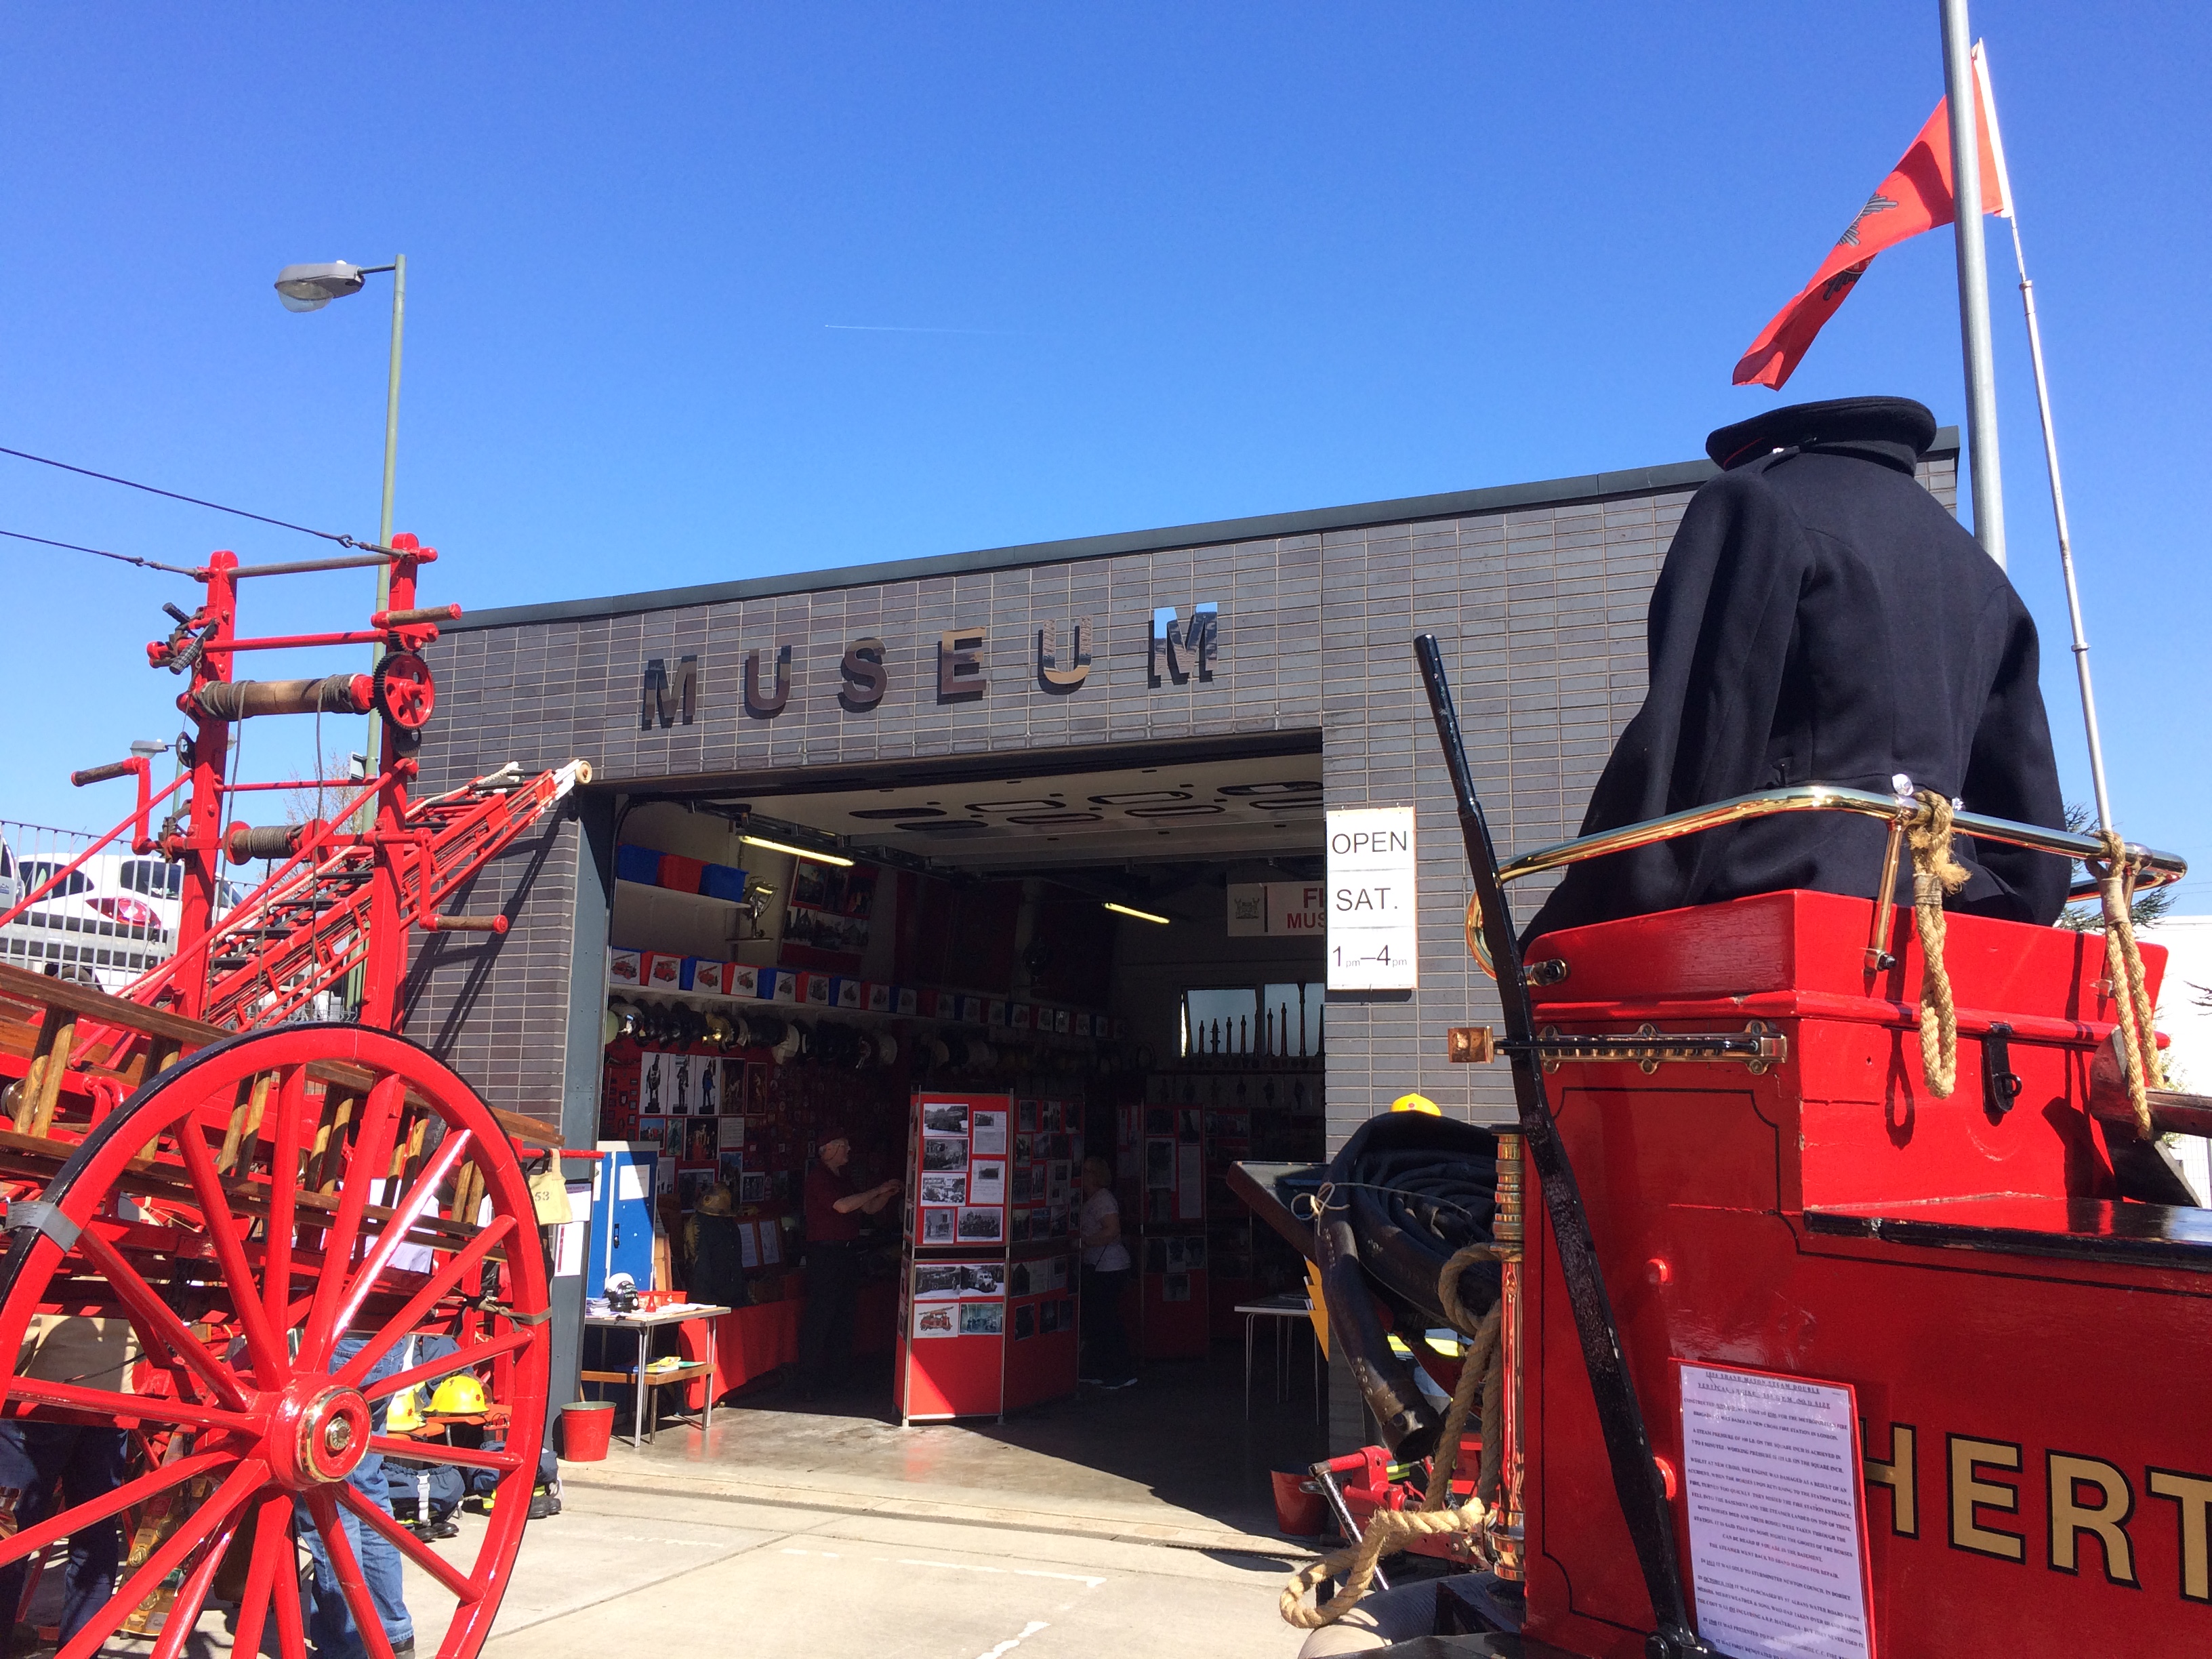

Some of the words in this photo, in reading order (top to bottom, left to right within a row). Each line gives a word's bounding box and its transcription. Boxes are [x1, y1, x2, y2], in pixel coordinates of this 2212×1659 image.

[643, 601, 1218, 724] MUSEUM
[1332, 830, 1407, 854] OPEN
[1336, 888, 1397, 912] SAT.
[535, 1191, 550, 1202] 53
